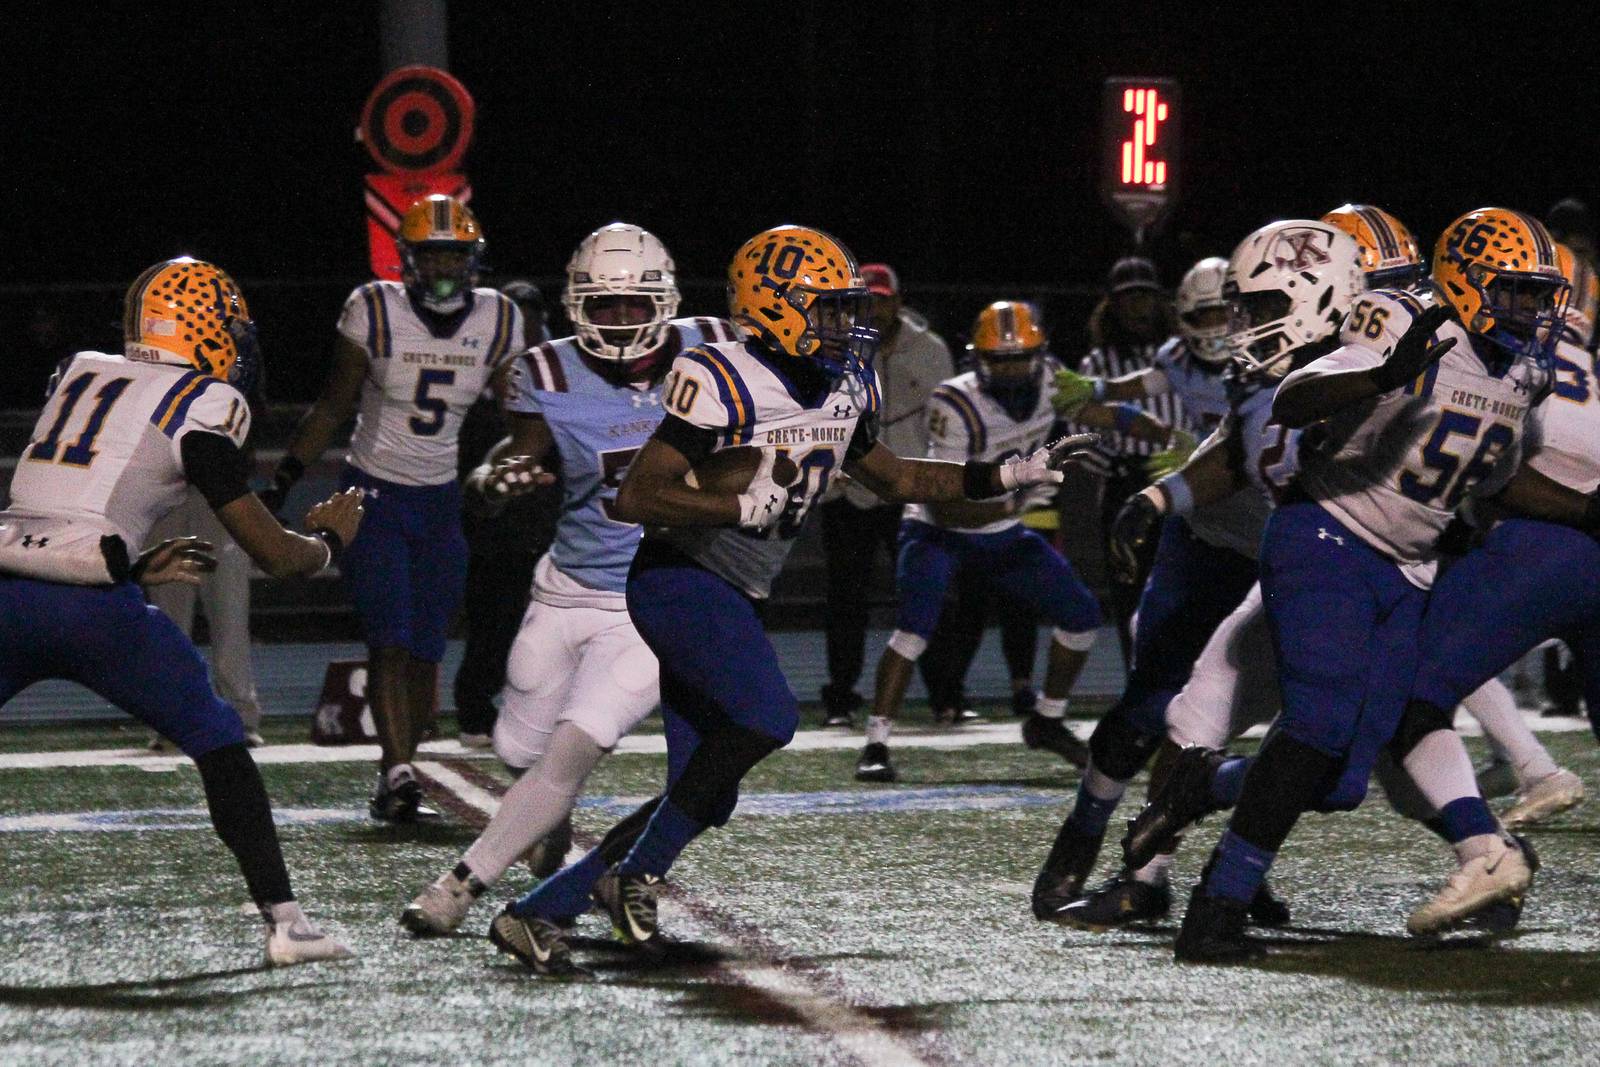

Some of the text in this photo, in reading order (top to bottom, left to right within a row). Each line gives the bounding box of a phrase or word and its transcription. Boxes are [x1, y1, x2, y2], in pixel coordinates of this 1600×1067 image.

[1121, 87, 1168, 185] 2
[754, 241, 806, 279] 10
[1350, 299, 1391, 340] 56
[26, 371, 136, 469] 11
[409, 368, 458, 437] 5
[665, 369, 703, 417] 10
[766, 427, 847, 444] CRETE-MONEE
[1396, 404, 1517, 511] 56
